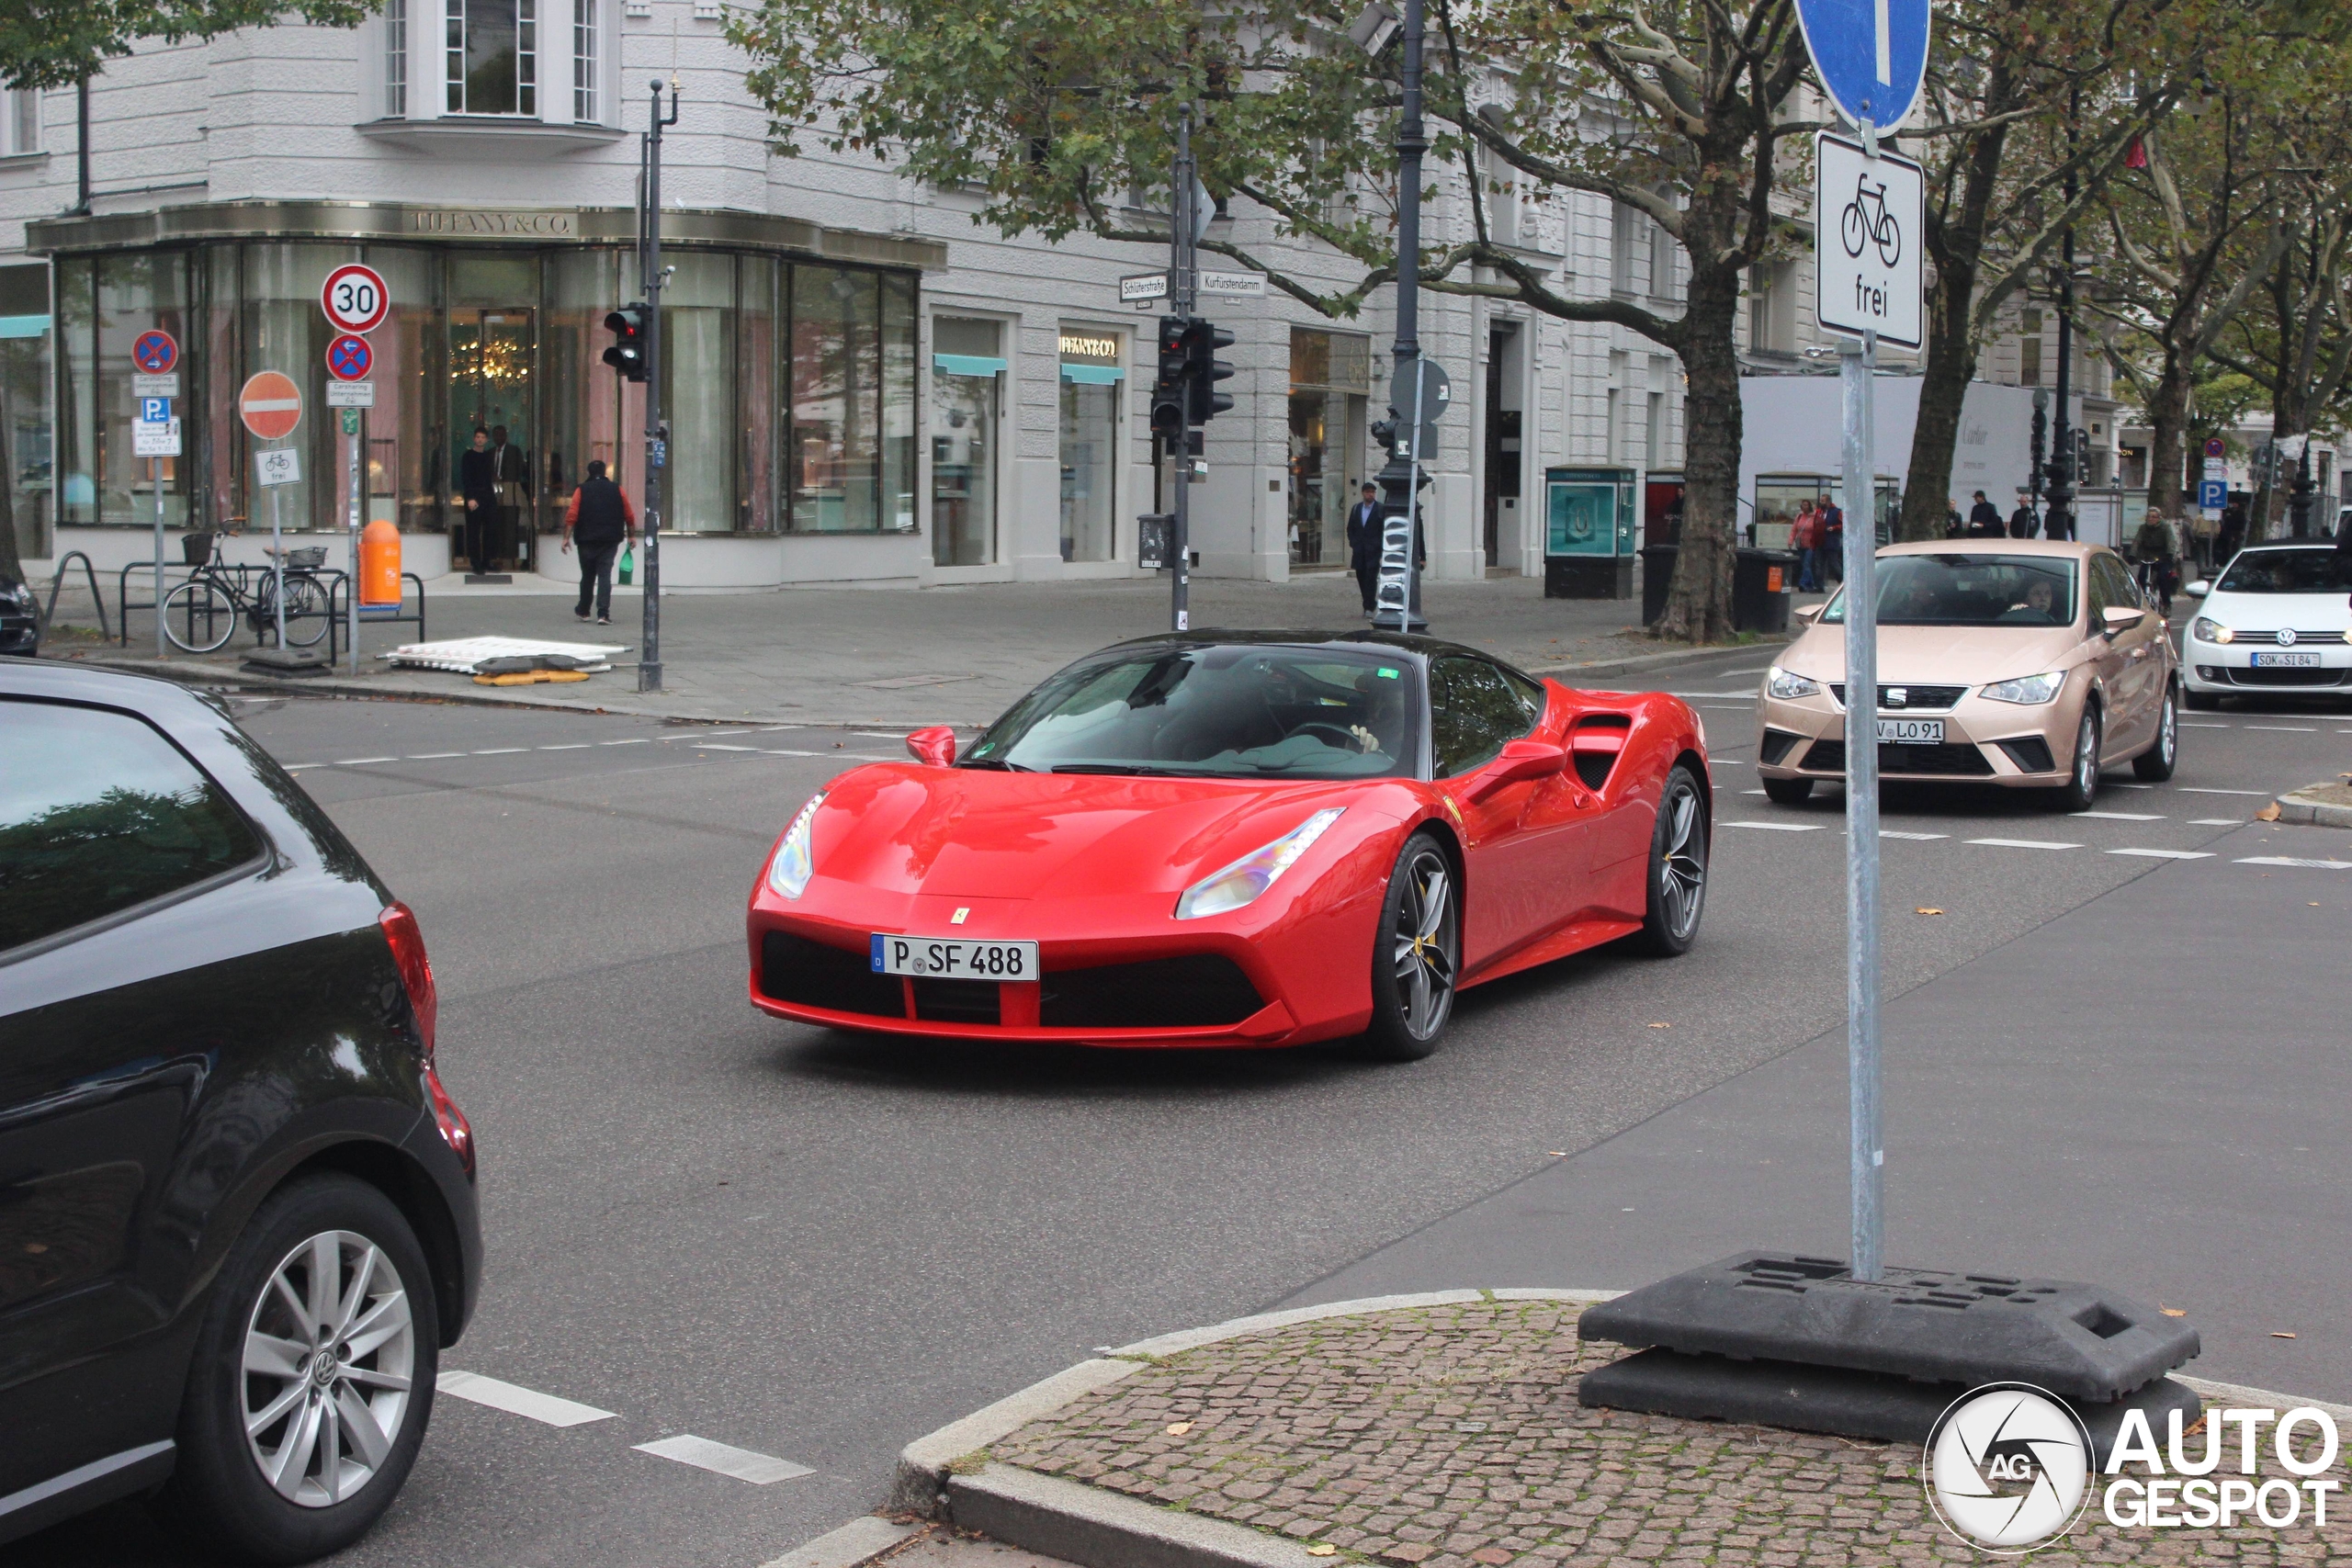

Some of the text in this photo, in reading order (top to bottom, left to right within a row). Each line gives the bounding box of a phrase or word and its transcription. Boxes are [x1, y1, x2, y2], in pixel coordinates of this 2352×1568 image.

[411, 212, 571, 234] TIFFANY&CO.
[1124, 278, 1165, 294] Schlüterstraße
[1204, 276, 1261, 290] Kurfürstendamm
[337, 284, 373, 314] 30
[1856, 274, 1887, 318] frei
[1058, 336, 1118, 358] IFFANY&CO.
[146, 400, 162, 421] P
[272, 472, 287, 480] frei
[2205, 485, 2221, 505] P
[2258, 655, 2278, 666] SOK
[2284, 655, 2296, 666] SI
[2299, 655, 2311, 666] 84
[1896, 723, 1917, 738] LO
[1922, 723, 1941, 739] 91
[894, 941, 1023, 975] P SF 488
